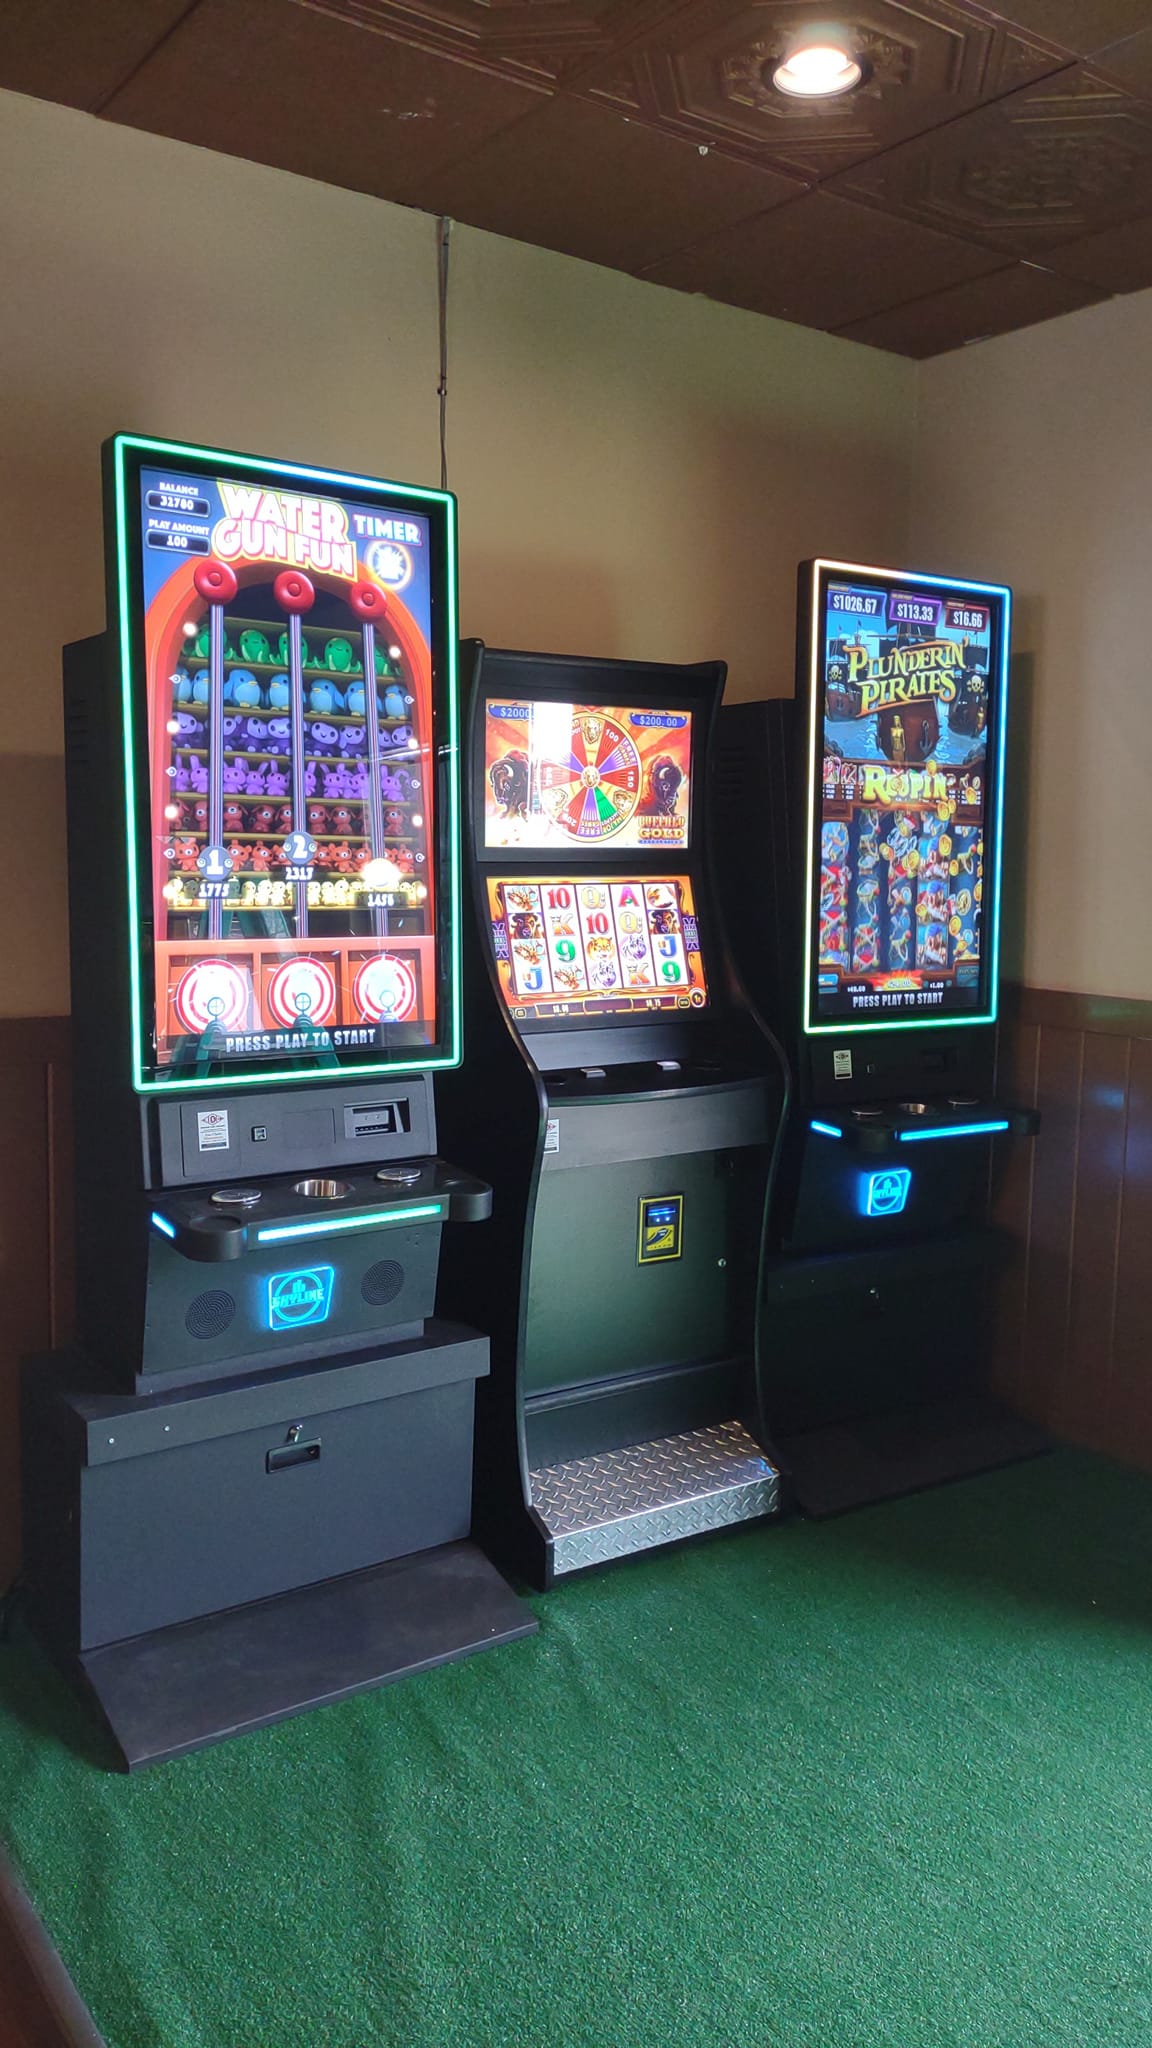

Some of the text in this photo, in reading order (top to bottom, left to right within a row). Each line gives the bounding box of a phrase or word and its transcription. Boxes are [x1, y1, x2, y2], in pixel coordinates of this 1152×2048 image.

[159, 482, 199, 497] BALANCE
[221, 484, 346, 545] WATER
[148, 518, 210, 536] PLAY AMOUNT
[353, 514, 422, 544] TIMER
[166, 534, 188, 548] 100
[214, 518, 288, 561] GUN
[294, 532, 355, 578] FUN
[833, 594, 877, 614] $1026.67
[897, 603, 934, 622] $113.33
[953, 610, 983, 628] $16.66
[842, 636, 969, 684] PLUNDERIN'
[856, 669, 957, 718] PIRATES
[605, 728, 619, 742] 100
[637, 827, 685, 839] GOLD
[293, 835, 308, 861] 2
[206, 849, 224, 875] 1
[285, 867, 314, 881] 2317
[199, 883, 230, 898] 1775
[547, 887, 571, 910] 10
[618, 885, 640, 908] A
[586, 912, 609, 935] 10
[556, 938, 577, 963] 9
[659, 935, 677, 958] J
[524, 967, 543, 991] J
[661, 960, 681, 984] 9
[852, 992, 943, 1008] PRESS PLAY TO START
[226, 1028, 376, 1052] PRESS PLAY TO START
